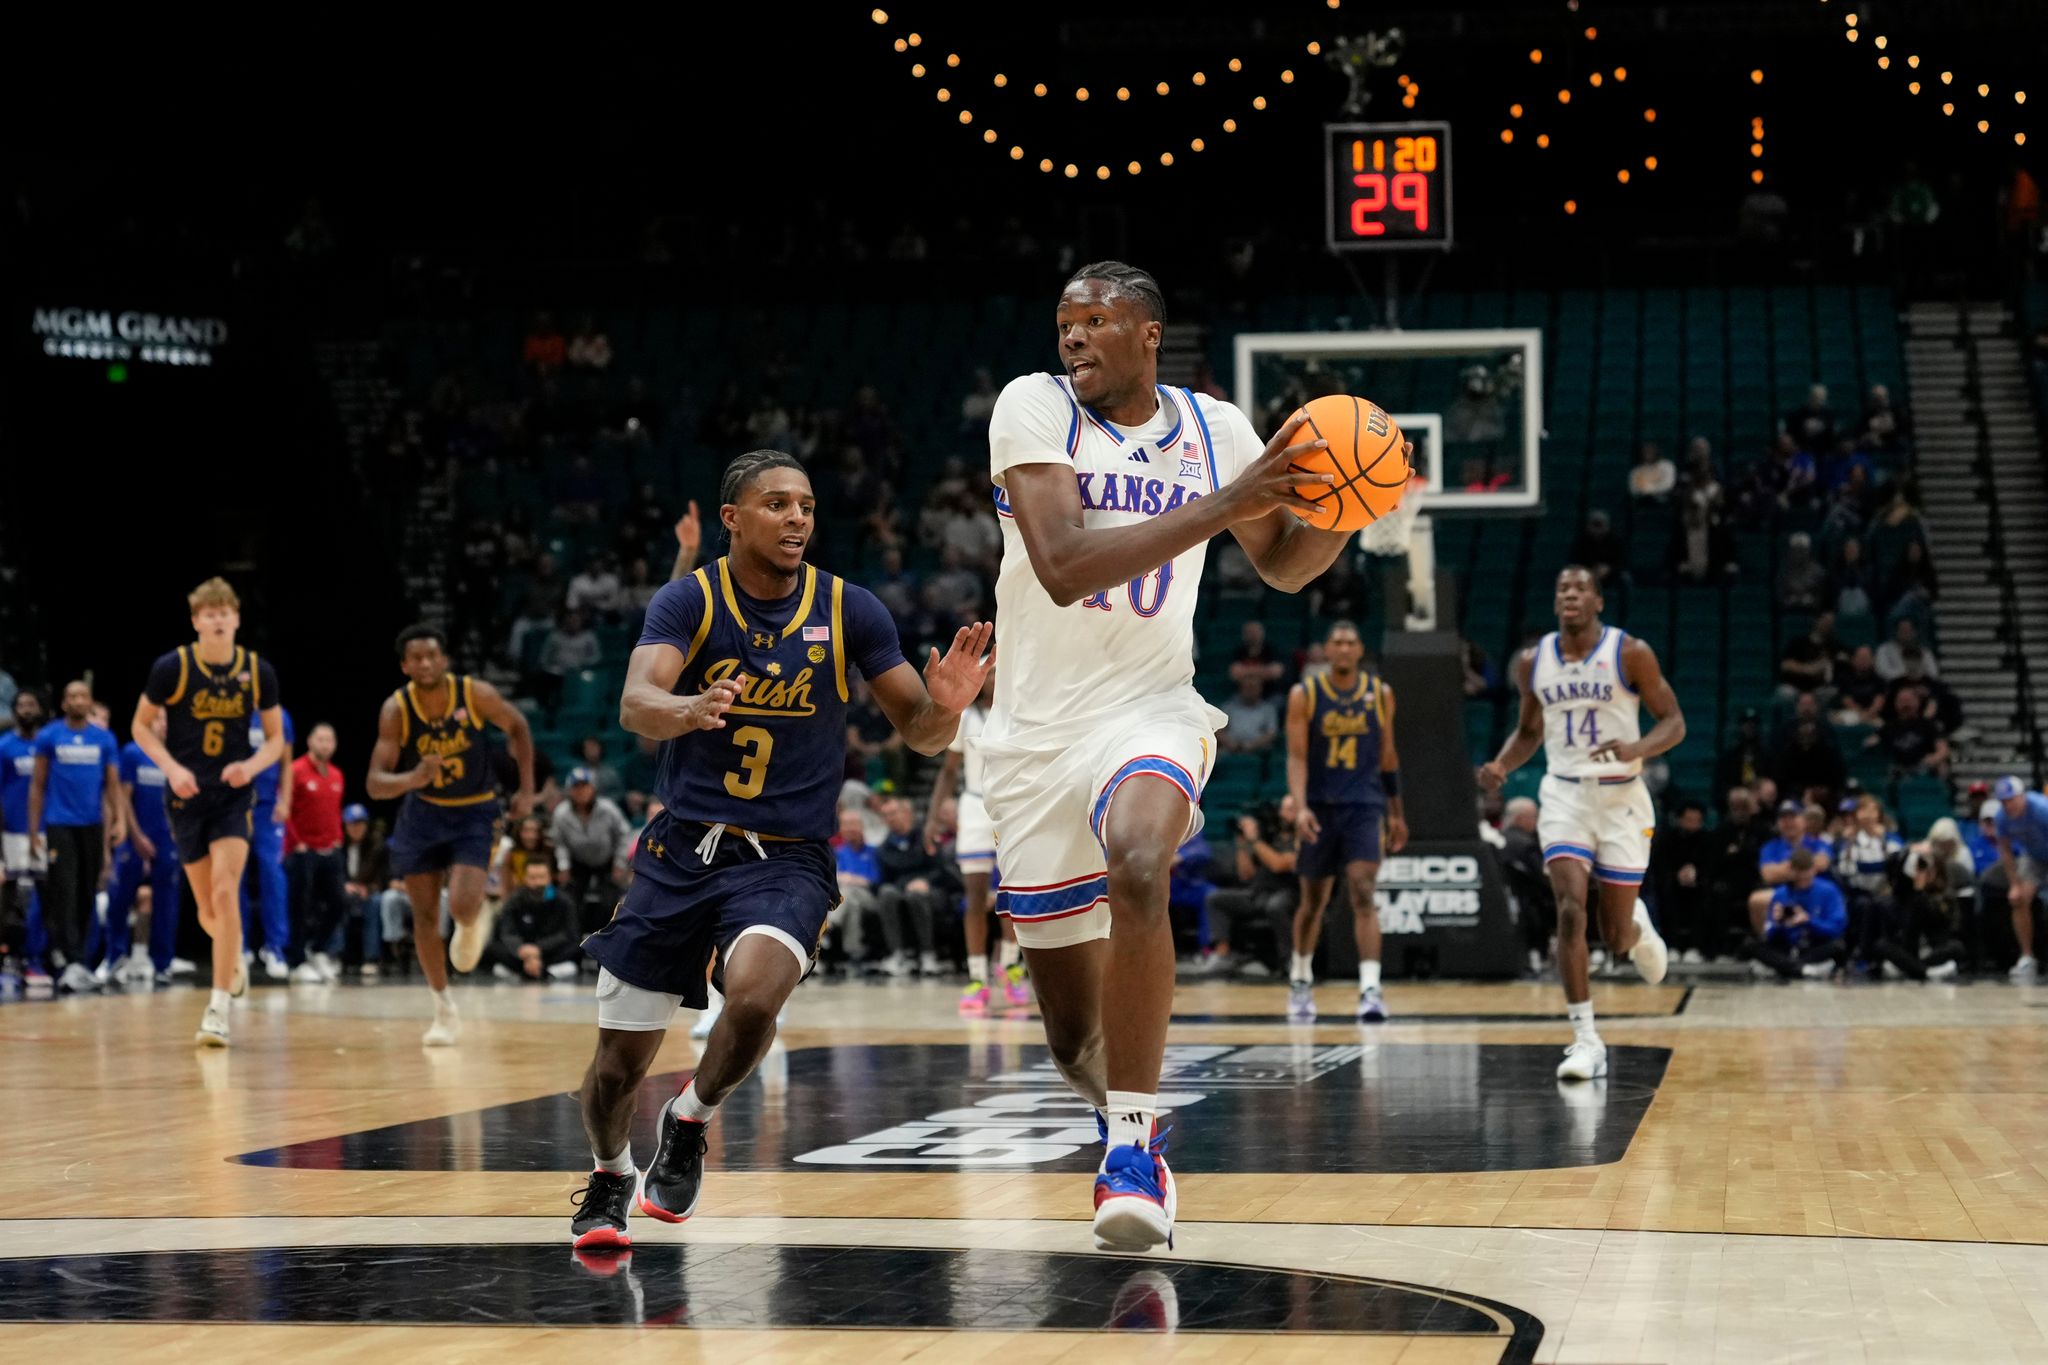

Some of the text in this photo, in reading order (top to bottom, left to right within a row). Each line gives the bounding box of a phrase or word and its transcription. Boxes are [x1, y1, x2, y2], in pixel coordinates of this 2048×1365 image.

[1351, 173, 1428, 235] 29
[33, 306, 227, 344] MGM GRAND
[1542, 681, 1613, 706] KANSAS
[203, 721, 225, 757] 6
[1562, 708, 1602, 747] 14
[723, 725, 774, 799] 3
